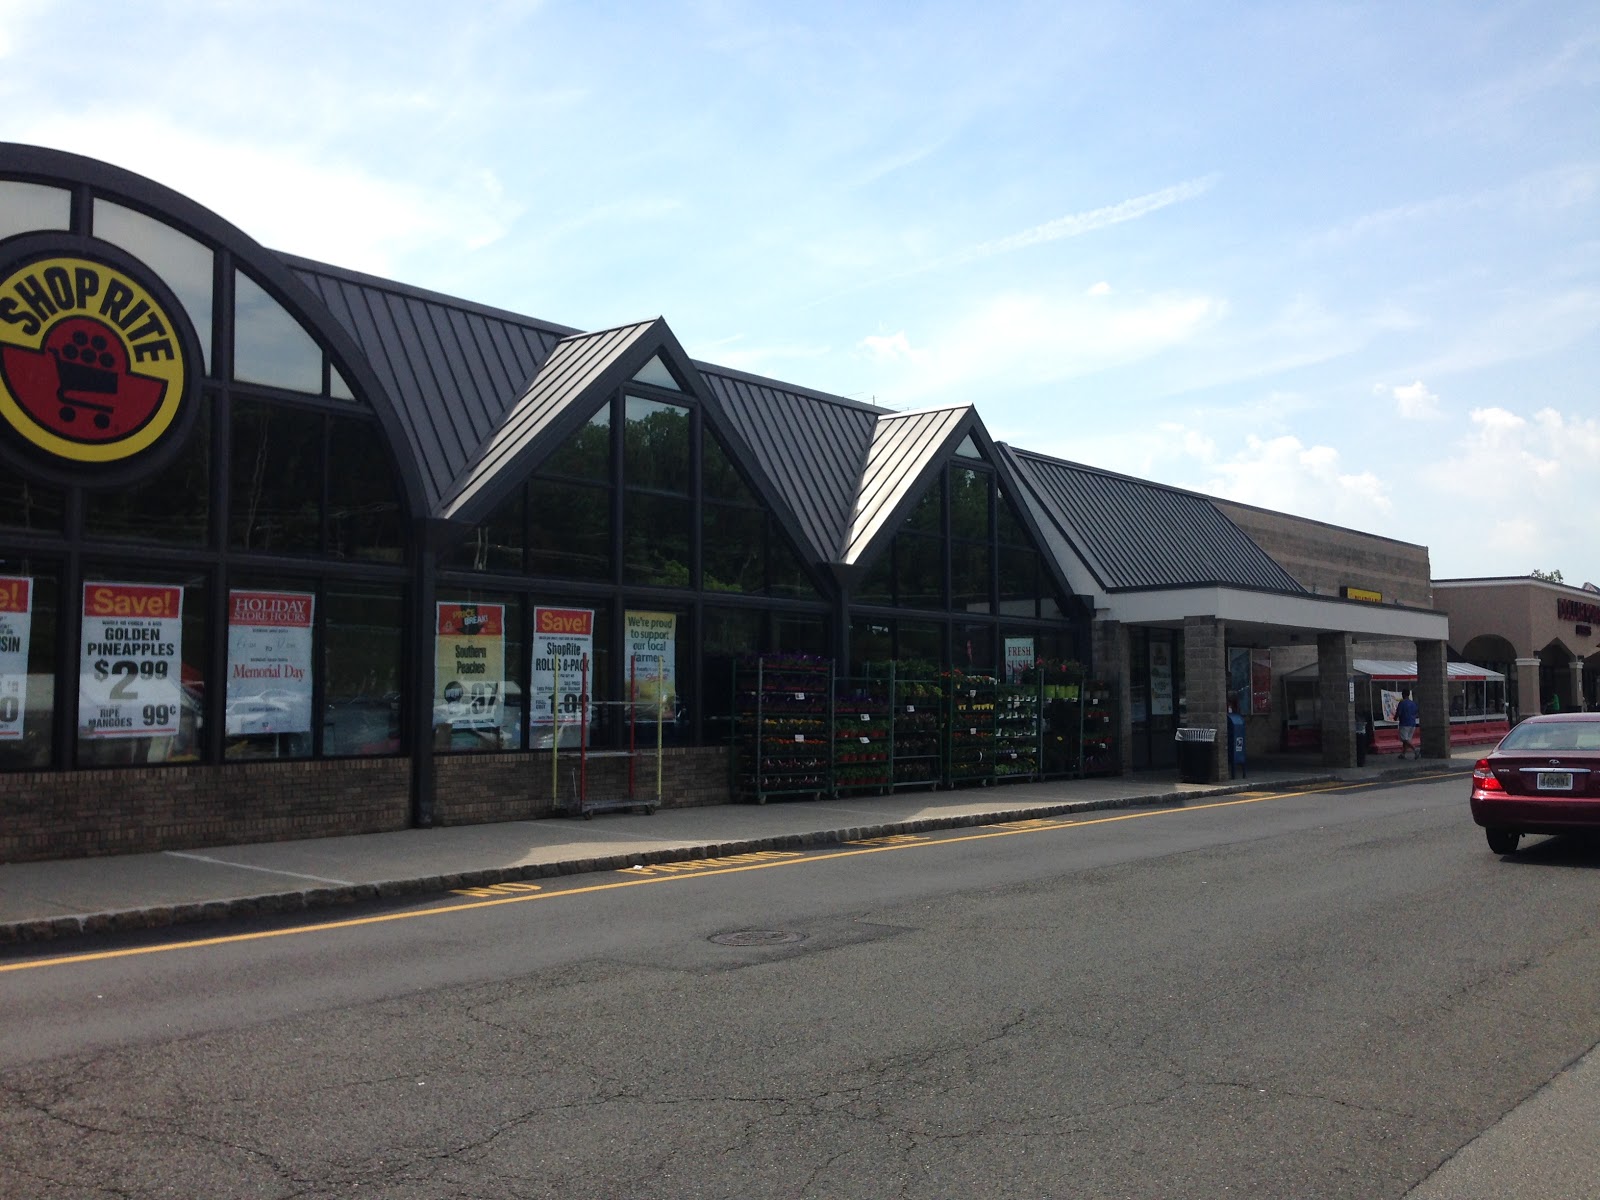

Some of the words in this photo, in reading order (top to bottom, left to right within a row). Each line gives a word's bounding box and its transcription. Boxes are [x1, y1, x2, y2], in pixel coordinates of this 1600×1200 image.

[0, 267, 100, 336] SHOP
[98, 277, 175, 363] RITE
[93, 588, 171, 615] Save!
[235, 598, 306, 613] HOLIDAY
[234, 611, 268, 621] STORE
[270, 613, 306, 622] HOURS
[541, 611, 587, 632] Save!
[627, 616, 650, 628] We're
[650, 619, 673, 630] proud
[105, 628, 160, 641] GOLDEN
[630, 629, 640, 639] to
[640, 631, 670, 641] support
[87, 643, 175, 656] PINEAPPLES
[455, 645, 487, 659] Southern
[546, 642, 580, 657] ShopRite
[633, 642, 646, 651] our
[647, 640, 667, 651] local
[1008, 646, 1031, 656] FRESH
[233, 664, 280, 679] Memorial
[283, 665, 305, 681] Day
[456, 661, 486, 674] Peaches
[100, 709, 119, 718] RIPE
[88, 718, 132, 728] MANGOES
